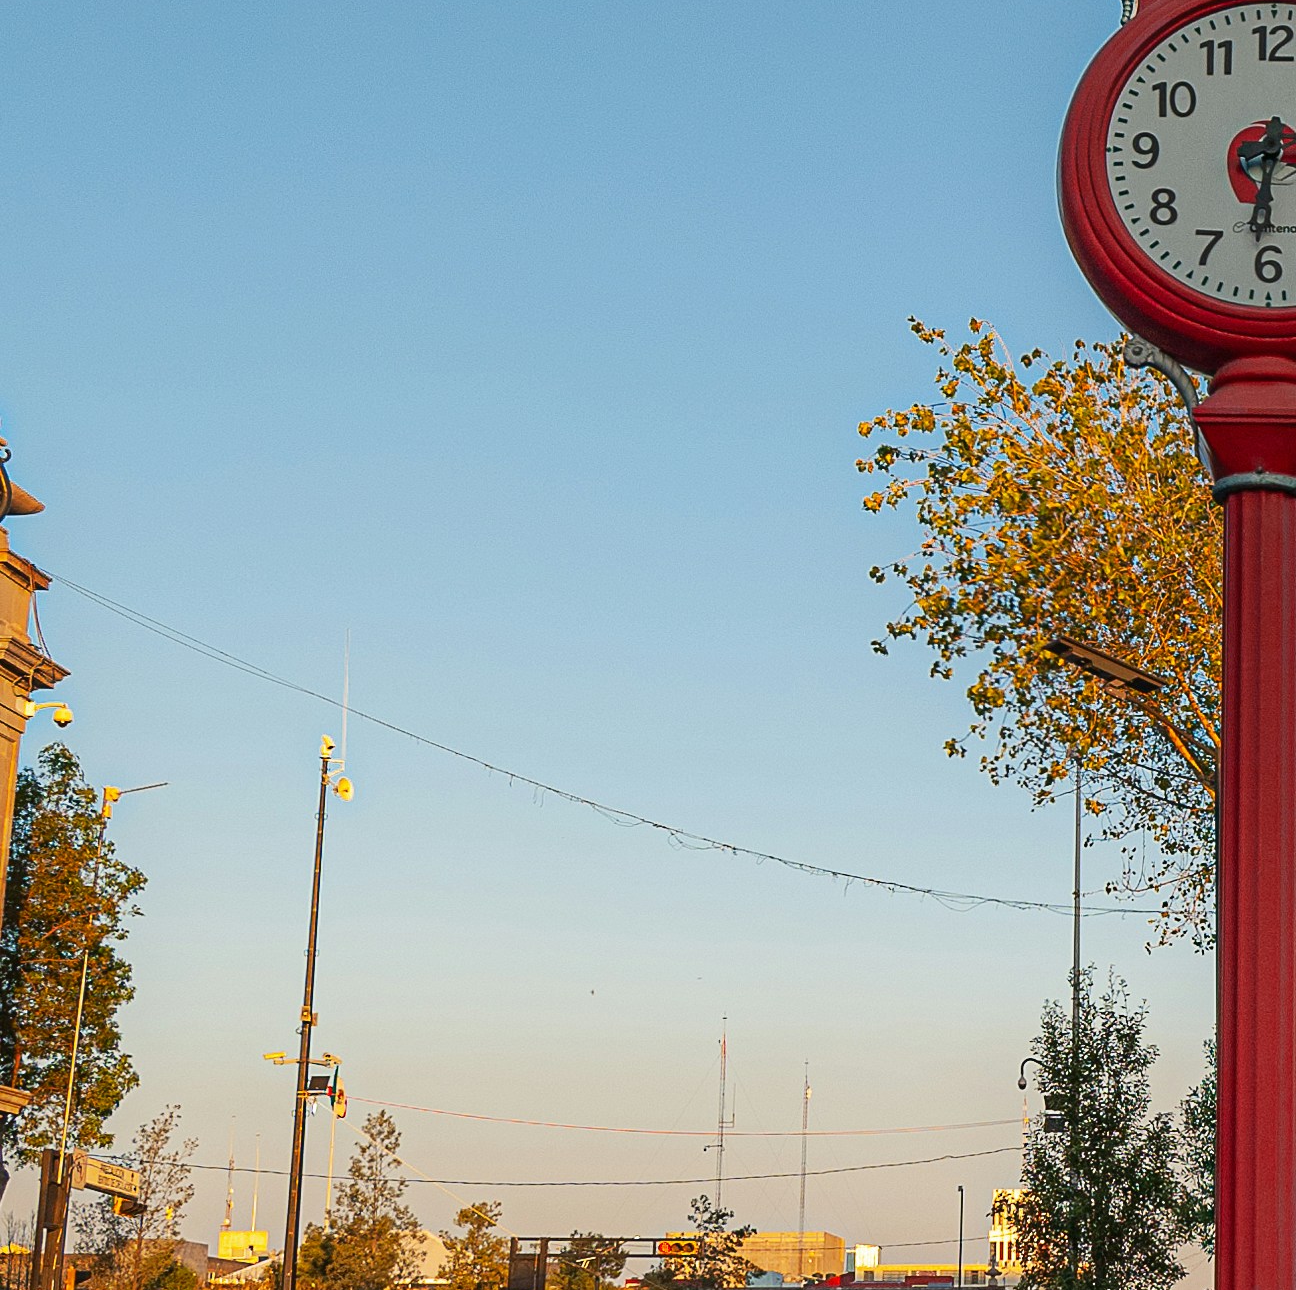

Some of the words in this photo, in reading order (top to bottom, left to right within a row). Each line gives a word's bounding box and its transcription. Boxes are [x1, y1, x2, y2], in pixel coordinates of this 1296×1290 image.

[1199, 40, 1233, 76] 11
[1251, 25, 1295, 62] 12
[1151, 81, 1197, 118] 10
[1131, 132, 1160, 170] 9
[1149, 187, 1178, 226] 8
[1194, 229, 1224, 266] 7
[1253, 245, 1283, 284] 6
